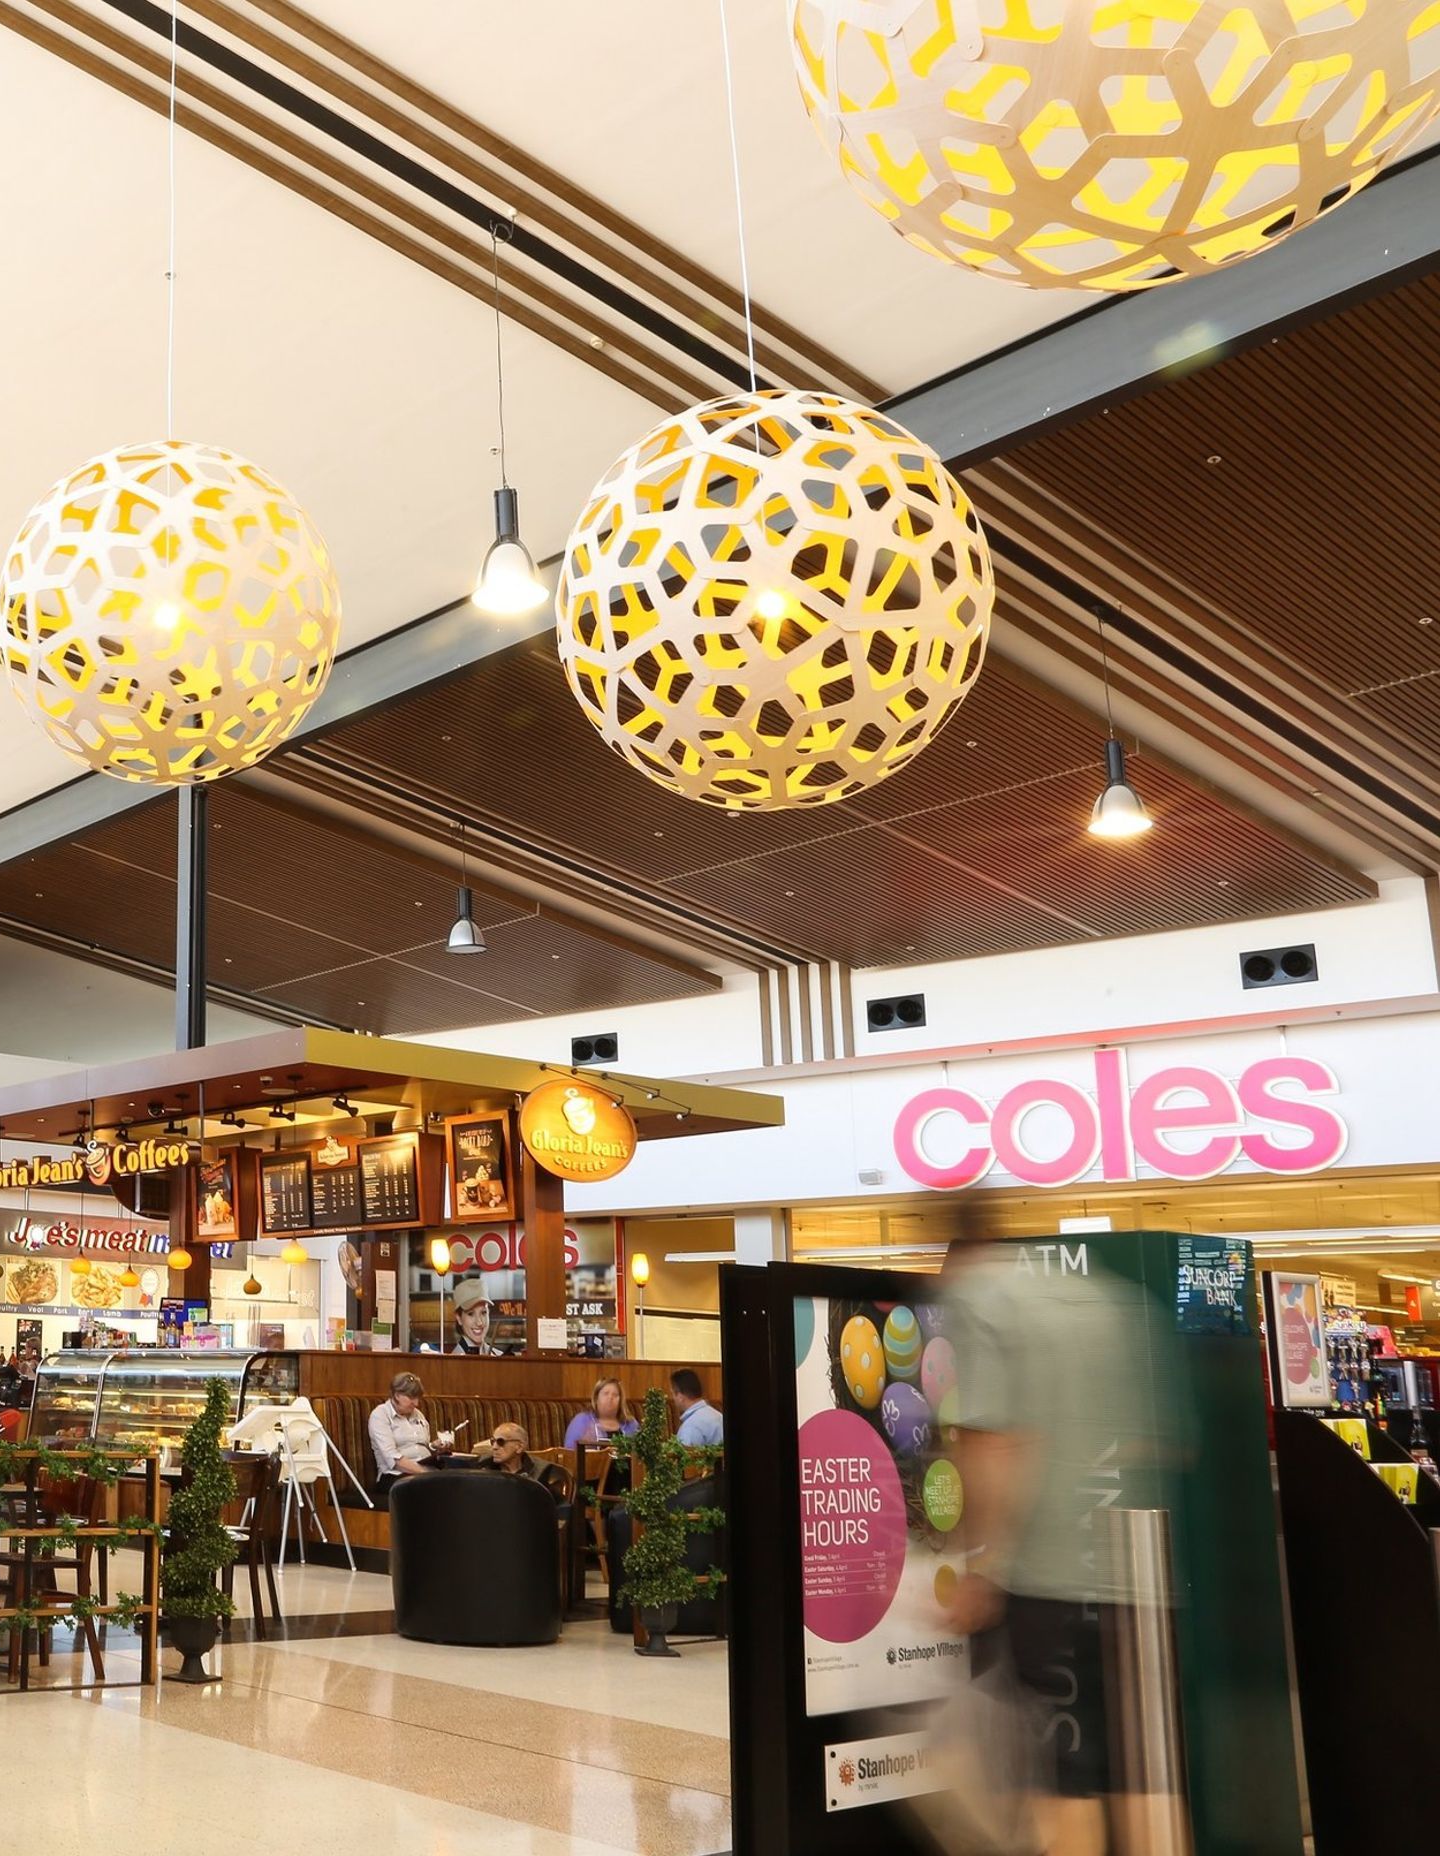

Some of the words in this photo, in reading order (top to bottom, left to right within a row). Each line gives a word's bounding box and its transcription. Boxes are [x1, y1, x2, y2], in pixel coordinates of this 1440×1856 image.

[893, 1048, 1347, 1191] coles
[531, 1128, 583, 1153] Gloria
[584, 1135, 628, 1158] Jean's
[31, 1152, 83, 1186] Jean's
[112, 1139, 189, 1175] Coffees
[553, 1154, 608, 1172] COFFEES
[81, 1227, 148, 1253] meat
[448, 1222, 580, 1273] cols
[1015, 1243, 1088, 1277] ATM
[1183, 1264, 1237, 1289] SUNCORP
[28, 1305, 44, 1313] Veal
[582, 1303, 603, 1316] ASK
[1206, 1287, 1239, 1306] BANK
[801, 1457, 871, 1484] EASTER
[801, 1487, 881, 1516] TRADING
[803, 1518, 869, 1547] HOURS
[898, 1645, 936, 1662] Stanhope
[936, 1642, 964, 1658] Village
[858, 1753, 915, 1780] Stanhope
